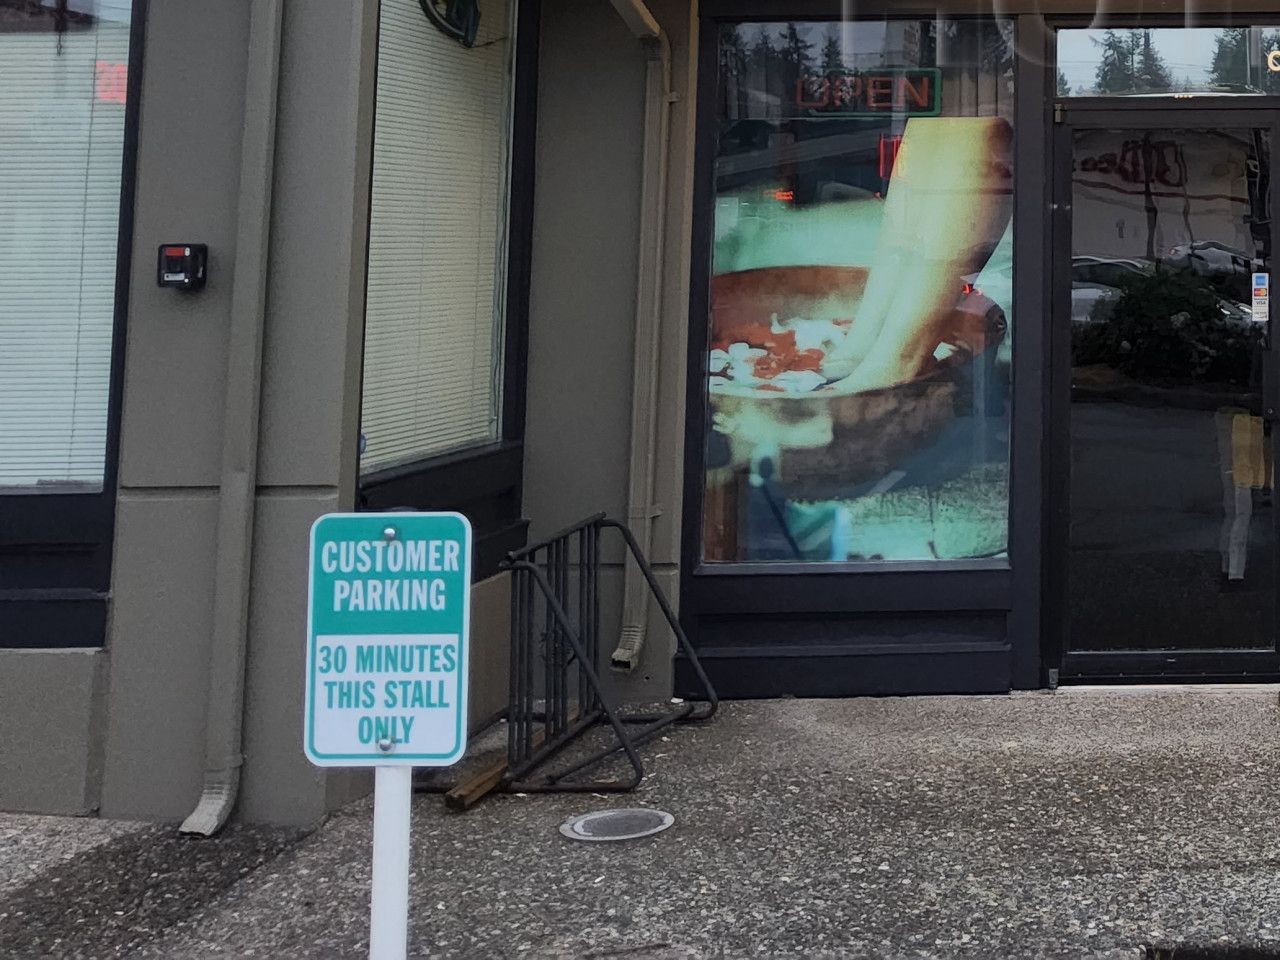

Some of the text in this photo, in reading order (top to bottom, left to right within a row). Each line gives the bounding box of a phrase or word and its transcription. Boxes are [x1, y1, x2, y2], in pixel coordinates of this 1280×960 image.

[797, 76, 929, 108] OPEN
[321, 540, 460, 573] CUSTOMER
[333, 578, 446, 612] PARKING
[318, 644, 456, 674] 30 MINUTES
[324, 680, 450, 709] THIS STALL
[358, 716, 415, 745] ONLY
